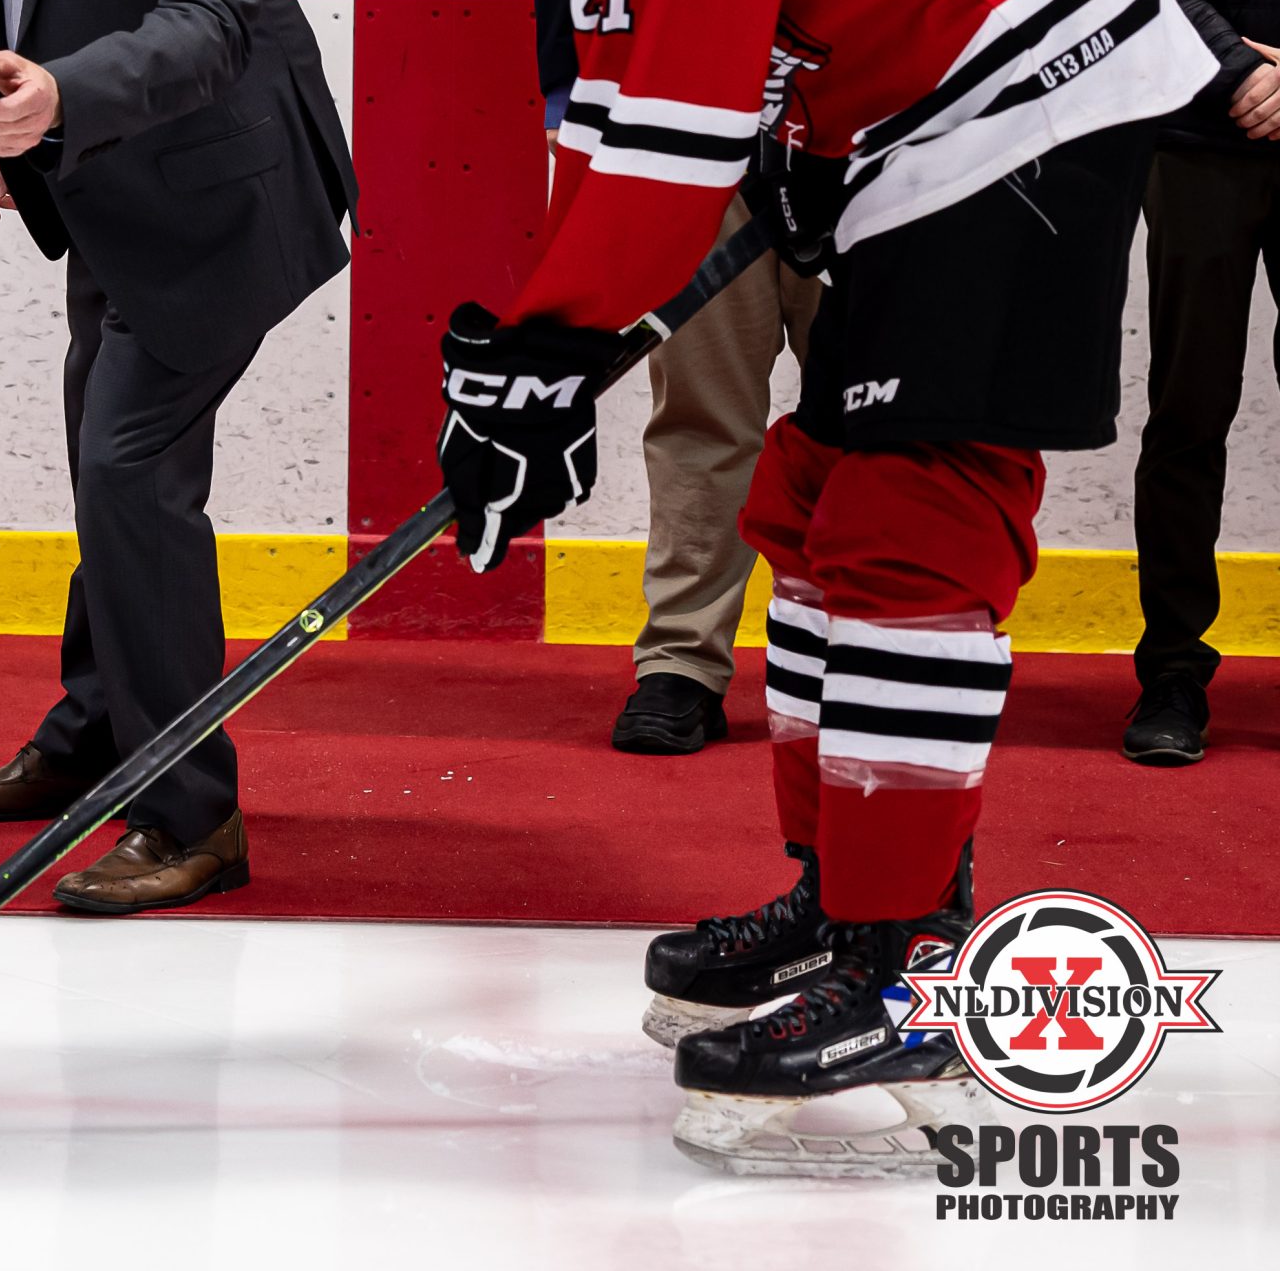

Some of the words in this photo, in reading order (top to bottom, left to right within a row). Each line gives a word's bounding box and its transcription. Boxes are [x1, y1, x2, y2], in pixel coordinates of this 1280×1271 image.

[1039, 53, 1080, 89] U-13
[1080, 28, 1115, 67] AAA
[779, 186, 797, 232] CCM
[442, 361, 586, 410] CM
[843, 378, 901, 415] CM
[777, 954, 830, 982] BAUER
